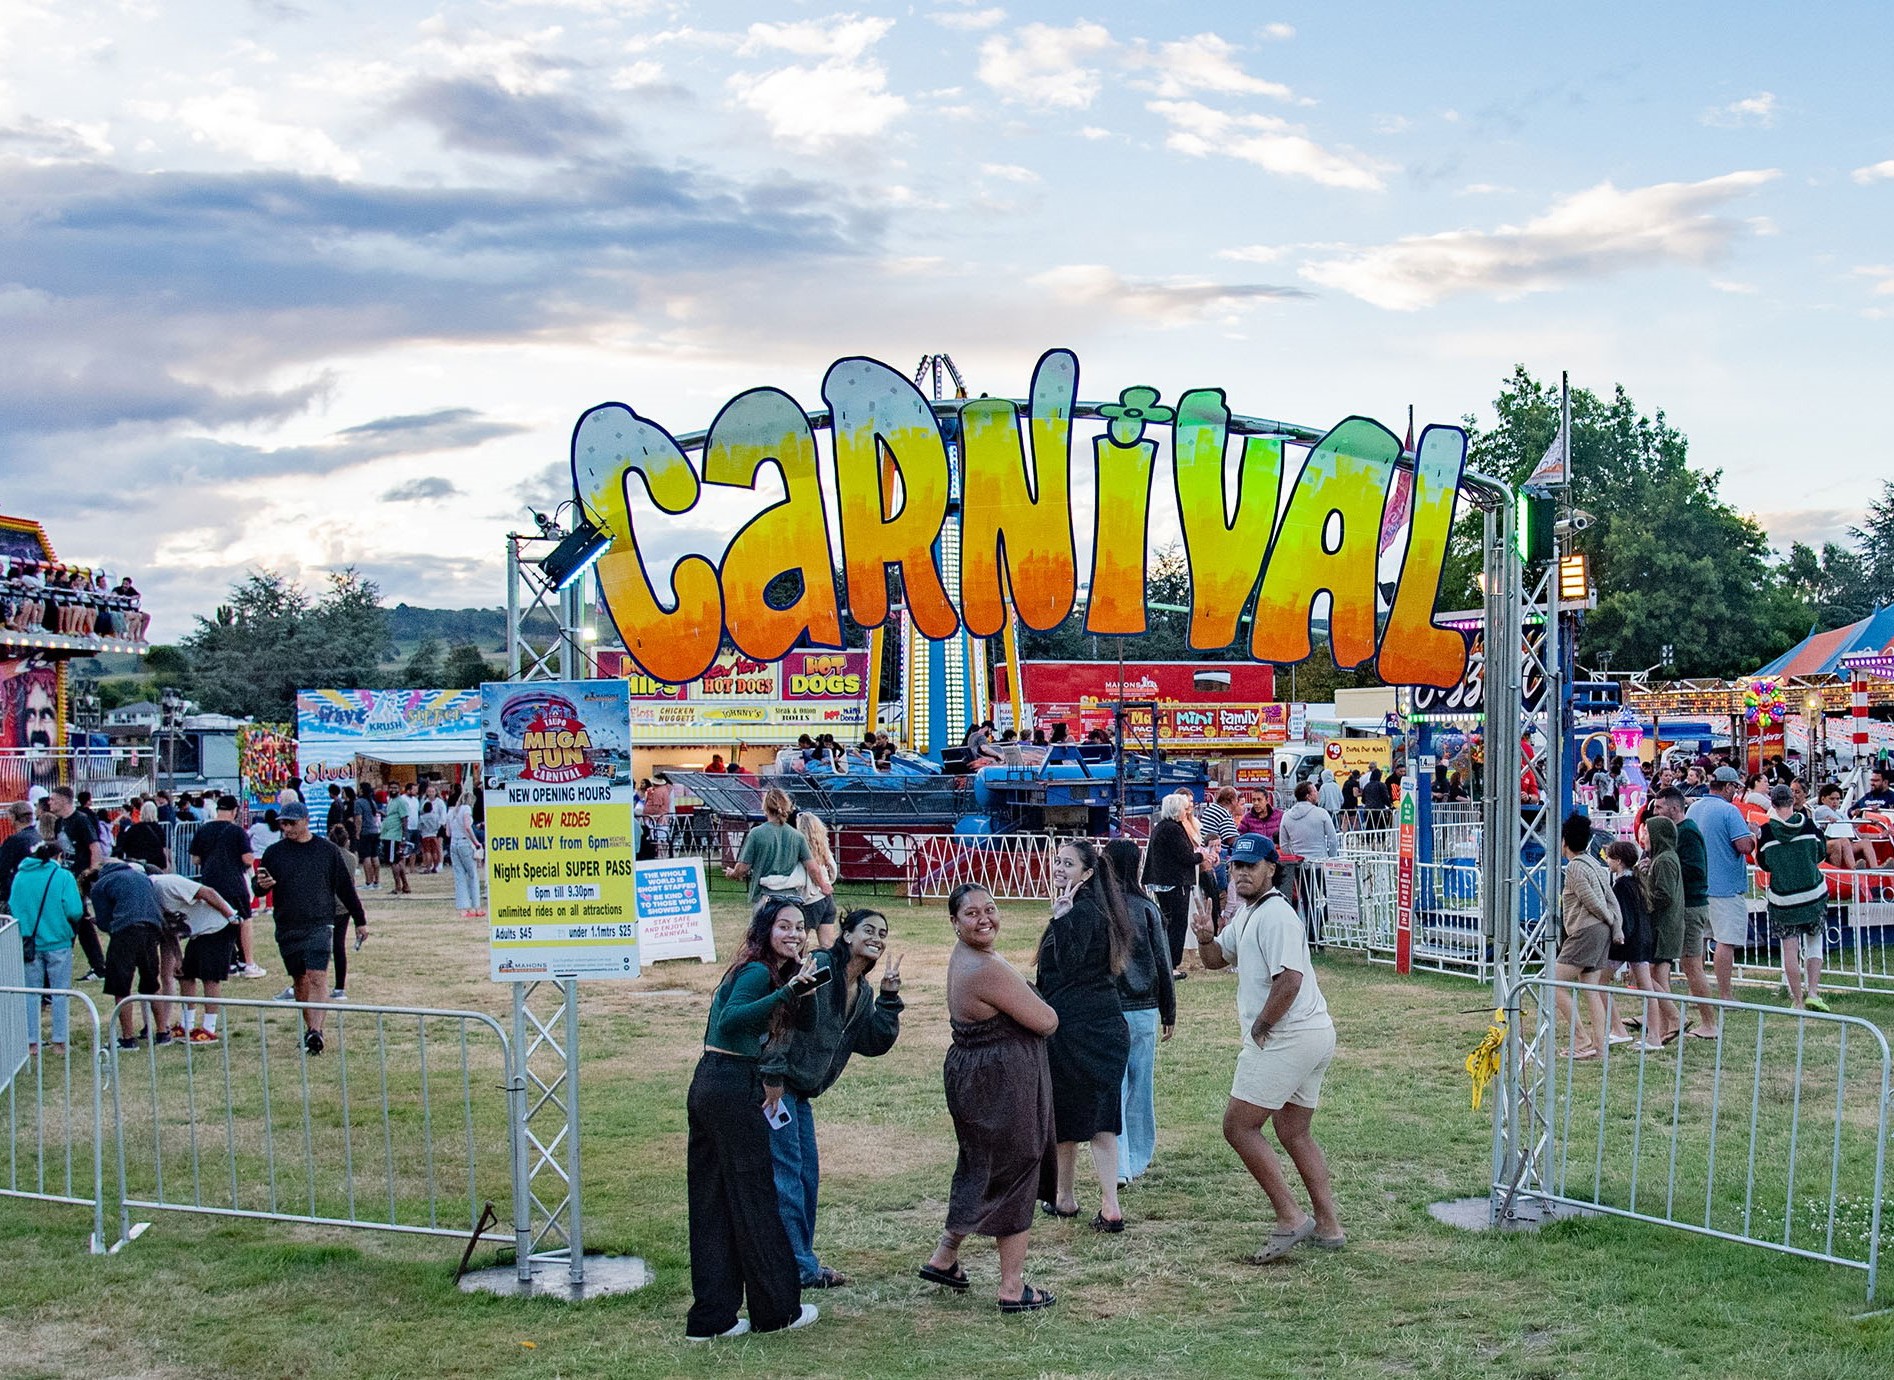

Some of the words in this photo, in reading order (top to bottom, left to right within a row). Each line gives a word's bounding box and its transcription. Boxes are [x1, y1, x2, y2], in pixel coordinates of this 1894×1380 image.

[805, 656, 846, 677] HOT
[702, 678, 733, 694] HOT
[735, 678, 773, 694] DOGS
[791, 675, 861, 695] DOGS
[722, 709, 762, 718] JOHNNY'S
[1176, 711, 1214, 725] Mini
[1220, 710, 1259, 725] family
[369, 721, 402, 731] KRUSH
[543, 718, 567, 727] TAUPO
[523, 730, 592, 750] MEGA
[528, 748, 585, 771] FUN
[533, 767, 582, 783] CARNIVAL
[509, 788, 530, 803] NEW
[533, 787, 575, 802] OPENING
[578, 786, 611, 801] HOURS
[530, 812, 554, 828] NEW
[560, 811, 591, 827] RIDES
[492, 837, 519, 851] OPEN
[525, 836, 554, 850] DAILY
[560, 836, 582, 849] from
[588, 835, 609, 852] 6pm
[494, 863, 520, 883] Night
[523, 862, 560, 881] Special
[566, 861, 600, 877] SUPER
[605, 860, 632, 876] PASS
[535, 886, 550, 901] 6pm
[554, 886, 564, 898] till
[568, 885, 595, 900] 9.30pm
[637, 885, 662, 893] SHORT
[664, 883, 696, 891] STAFFED
[498, 905, 532, 917] unlimited
[535, 905, 553, 917] rides
[557, 907, 566, 916] on
[570, 905, 579, 916] all
[583, 904, 622, 916] attractions
[648, 907, 680, 915] SHOWED
[495, 928, 516, 940] Adults
[520, 927, 532, 940] $45
[569, 926, 587, 938] under
[591, 925, 615, 937] 1.1mtrs
[619, 924, 631, 937] $25
[654, 930, 688, 938] CARNIVAL
